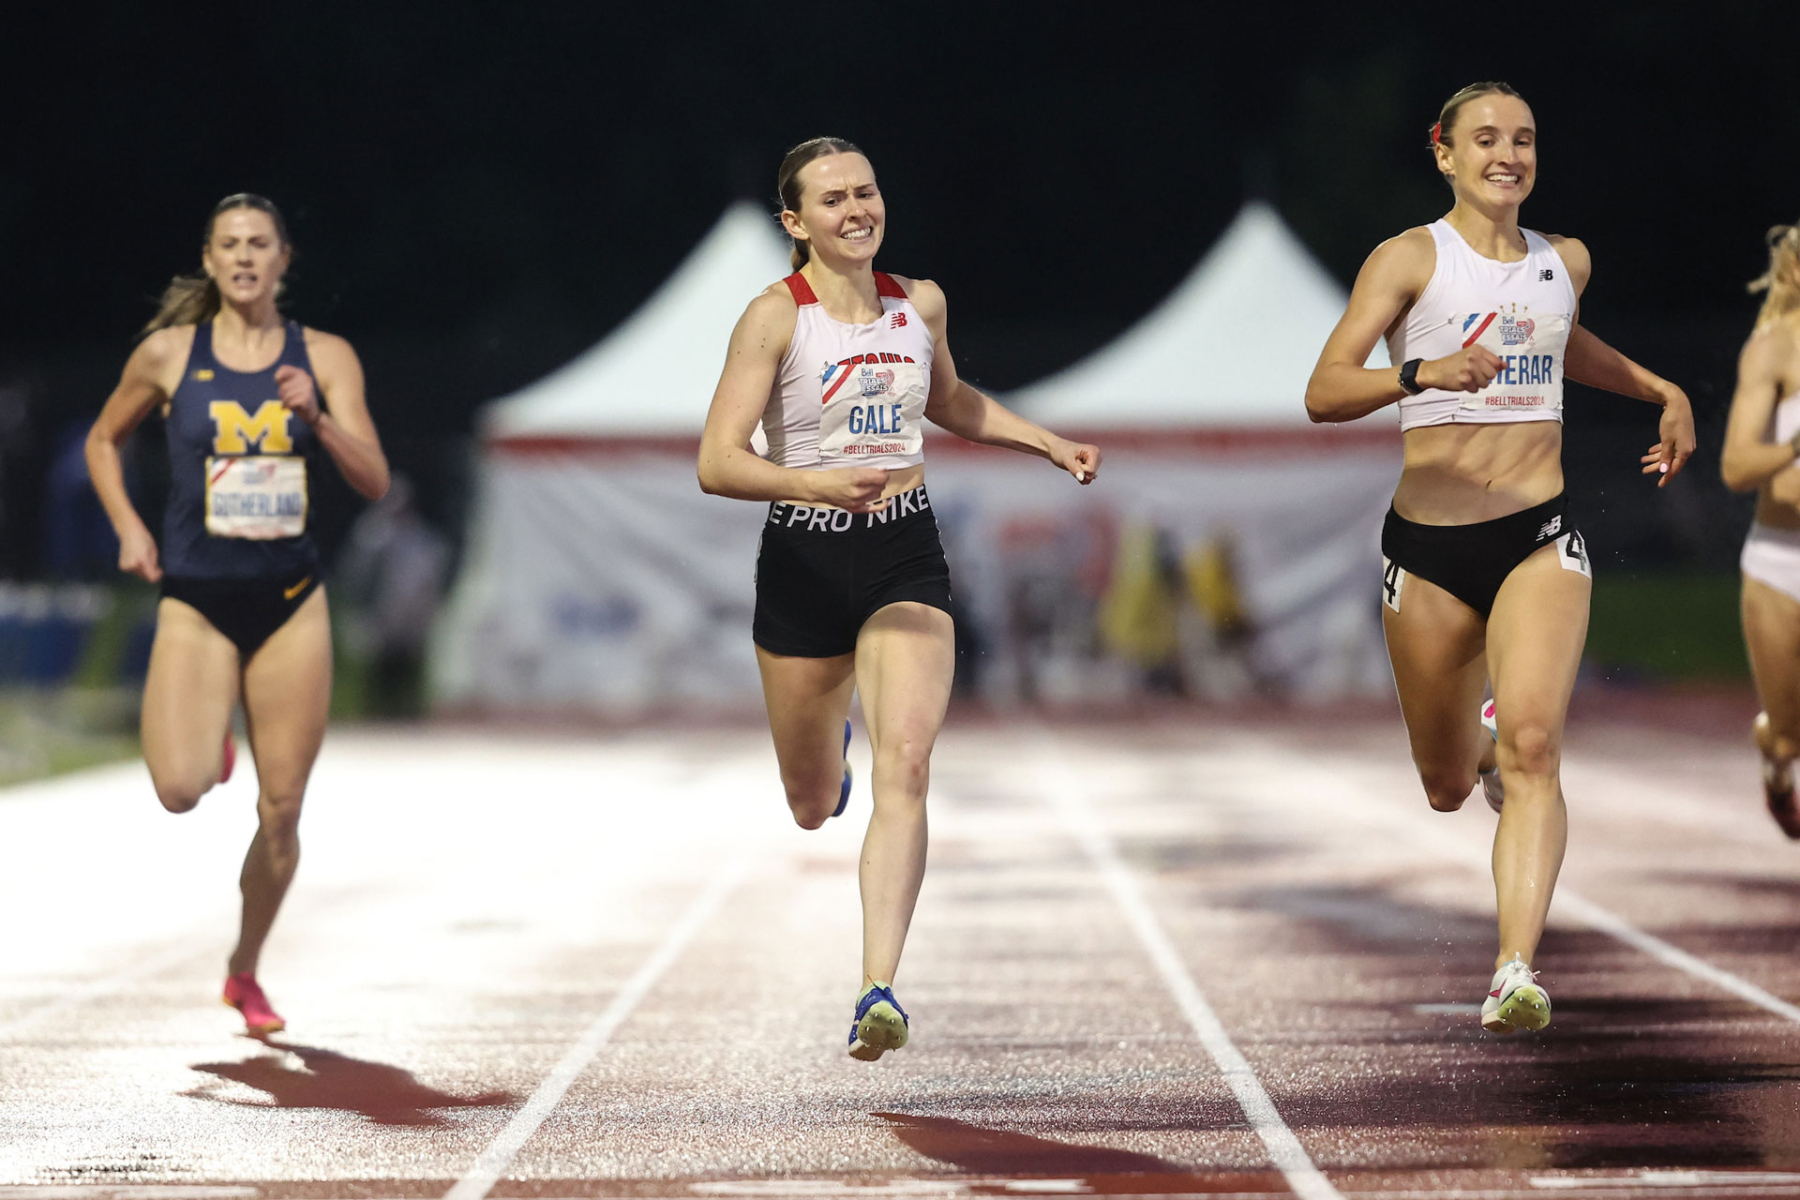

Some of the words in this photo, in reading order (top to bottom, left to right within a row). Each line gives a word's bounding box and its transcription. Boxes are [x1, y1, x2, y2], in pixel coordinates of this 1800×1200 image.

[1502, 316, 1515, 325] Bell
[1501, 333, 1529, 341] ESSAIS
[861, 368, 874, 377] Bell
[858, 377, 887, 385] TRIALS
[861, 384, 889, 392] ESSAIS
[1485, 396, 1545, 406] #BELLTRIALS2024
[848, 404, 902, 434] GALE
[209, 400, 293, 454] M
[843, 443, 906, 455] #BELLTRIALS2024
[786, 506, 853, 532] PRO
[1566, 532, 1587, 571] 4
[1383, 560, 1399, 604] 4
